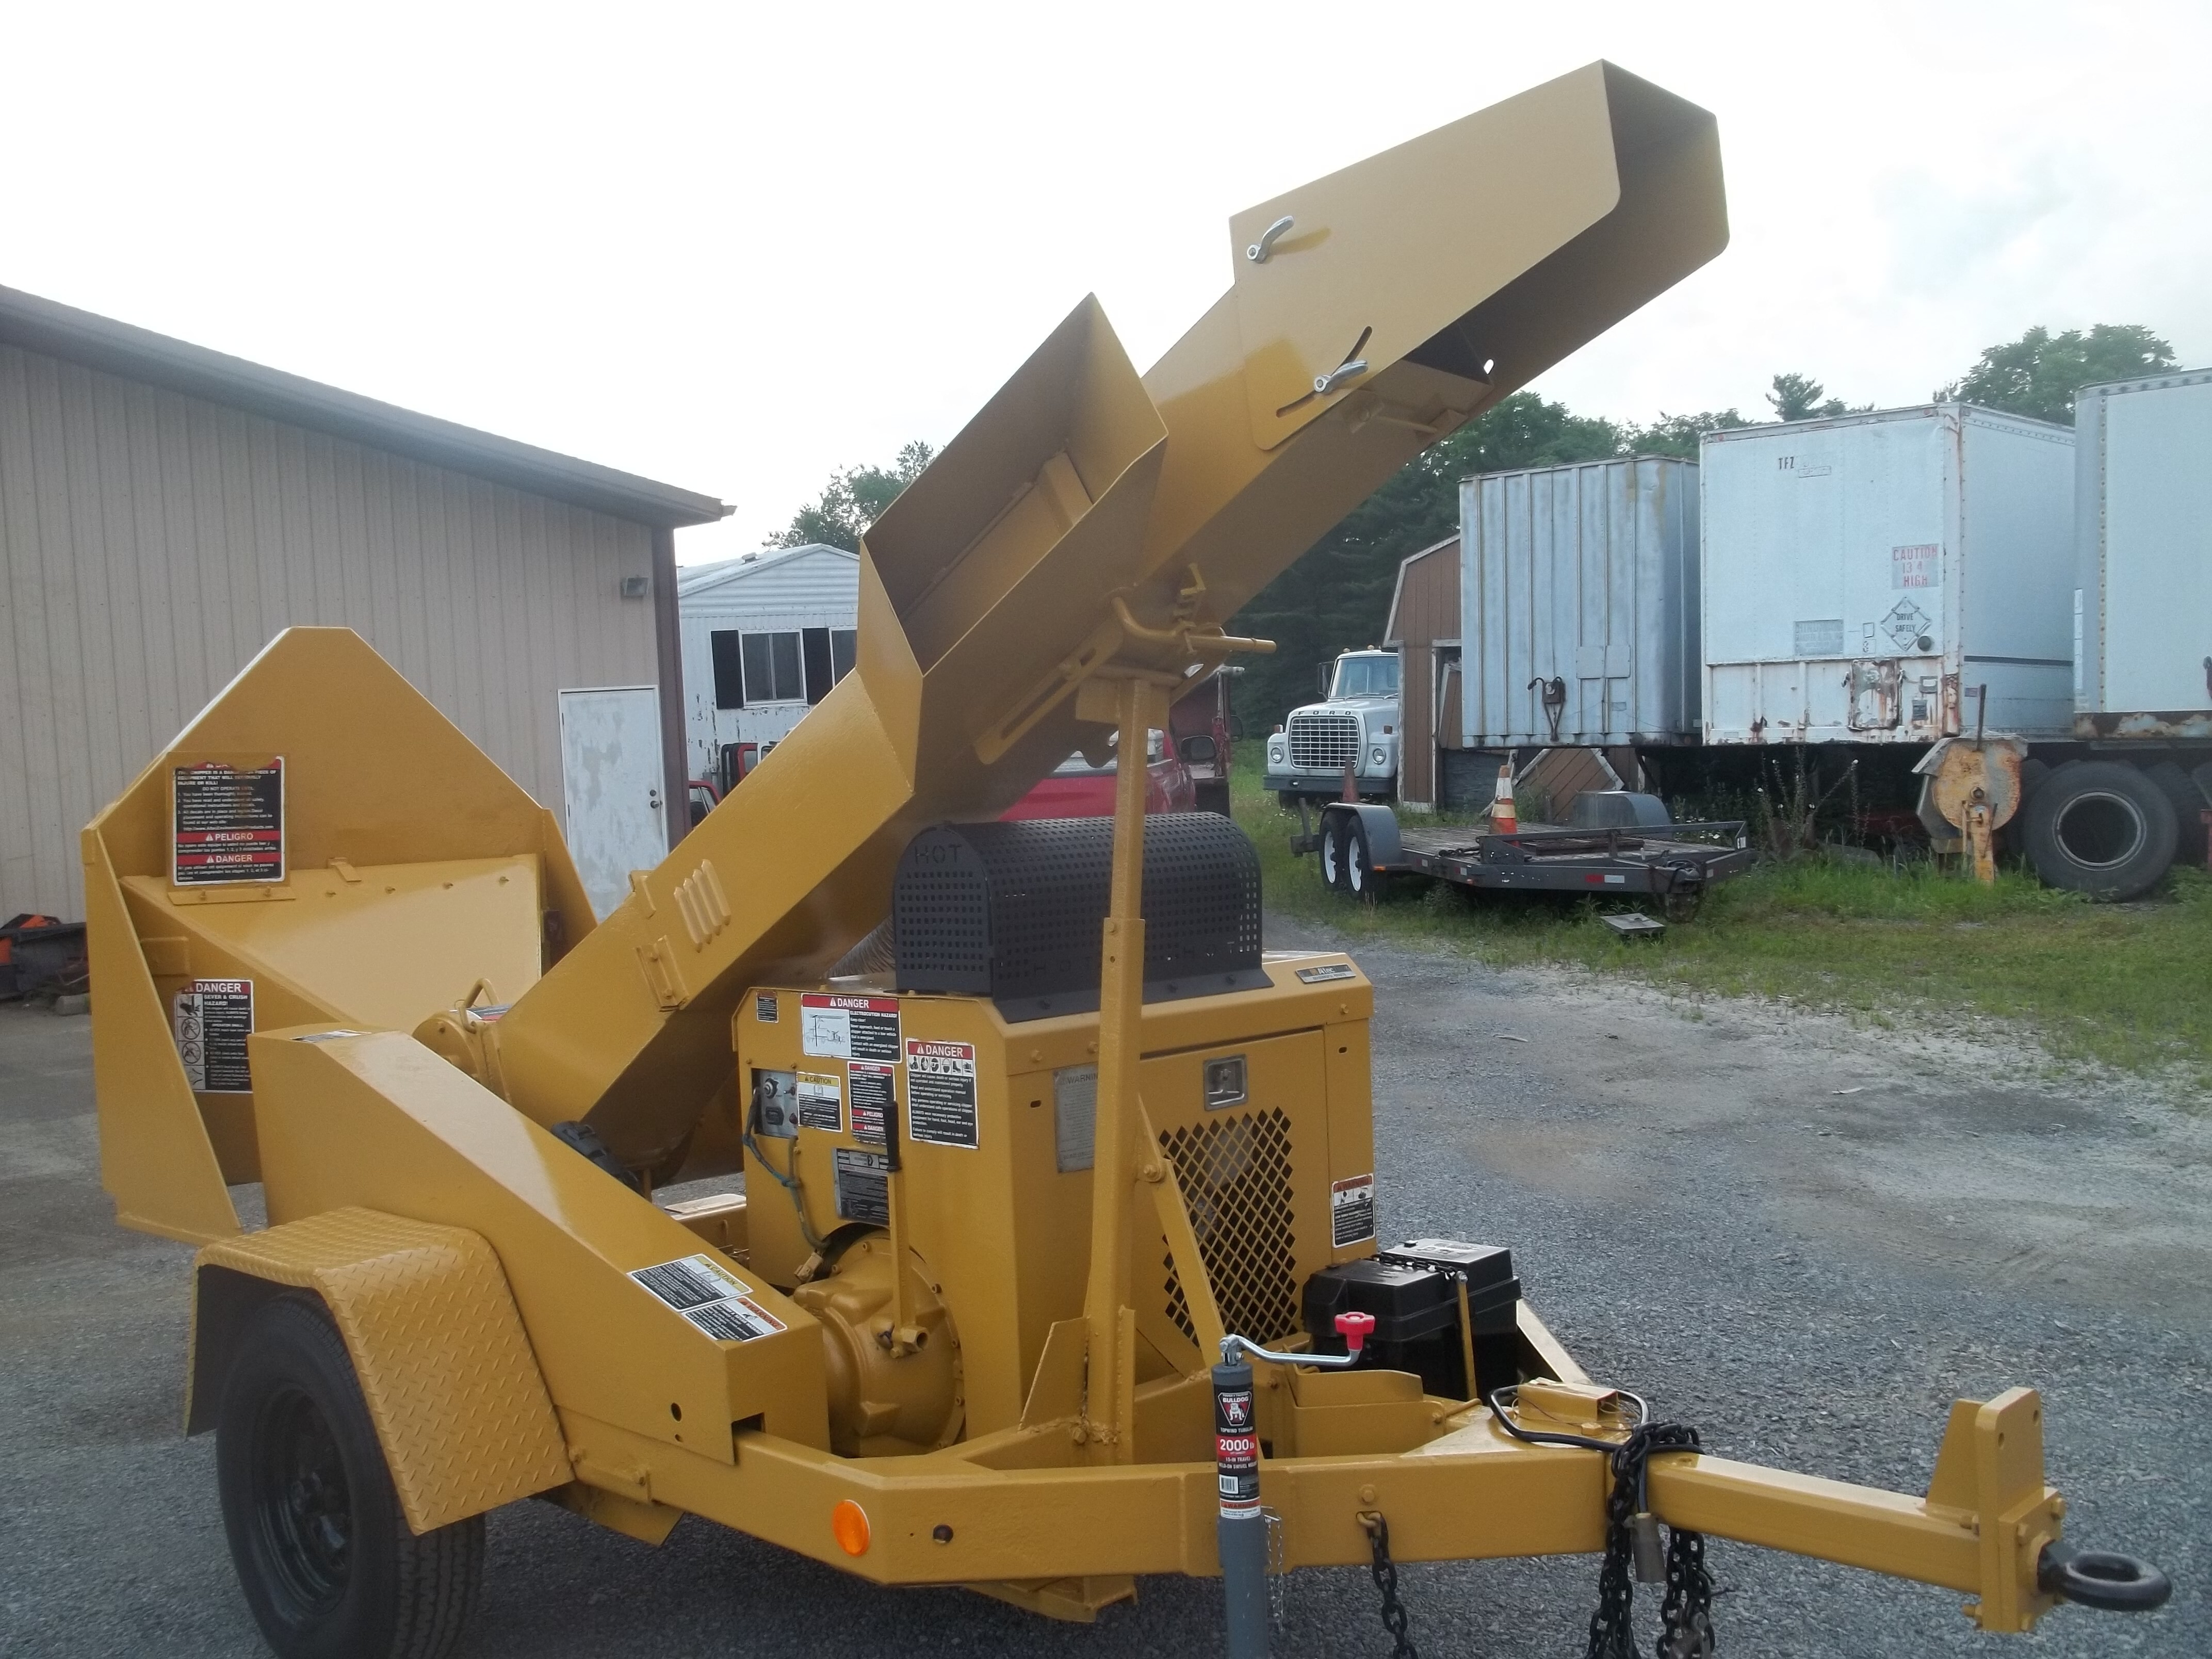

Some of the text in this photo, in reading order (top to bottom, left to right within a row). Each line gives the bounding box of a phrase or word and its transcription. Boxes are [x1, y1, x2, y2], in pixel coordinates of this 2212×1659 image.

[1894, 545, 1937, 561] CAUTION
[1904, 575, 1927, 587] HIGH
[914, 844, 962, 864] HOT
[197, 983, 241, 993] DANGER
[837, 998, 869, 1009] DANGER
[926, 1045, 963, 1058] DANGER
[1067, 1073, 1098, 1084] WARNIN
[1344, 1178, 1368, 1189] WARNING
[709, 1264, 738, 1285] CAUTION
[749, 1304, 780, 1327] WARNING
[1220, 1439, 1249, 1451] 2000
